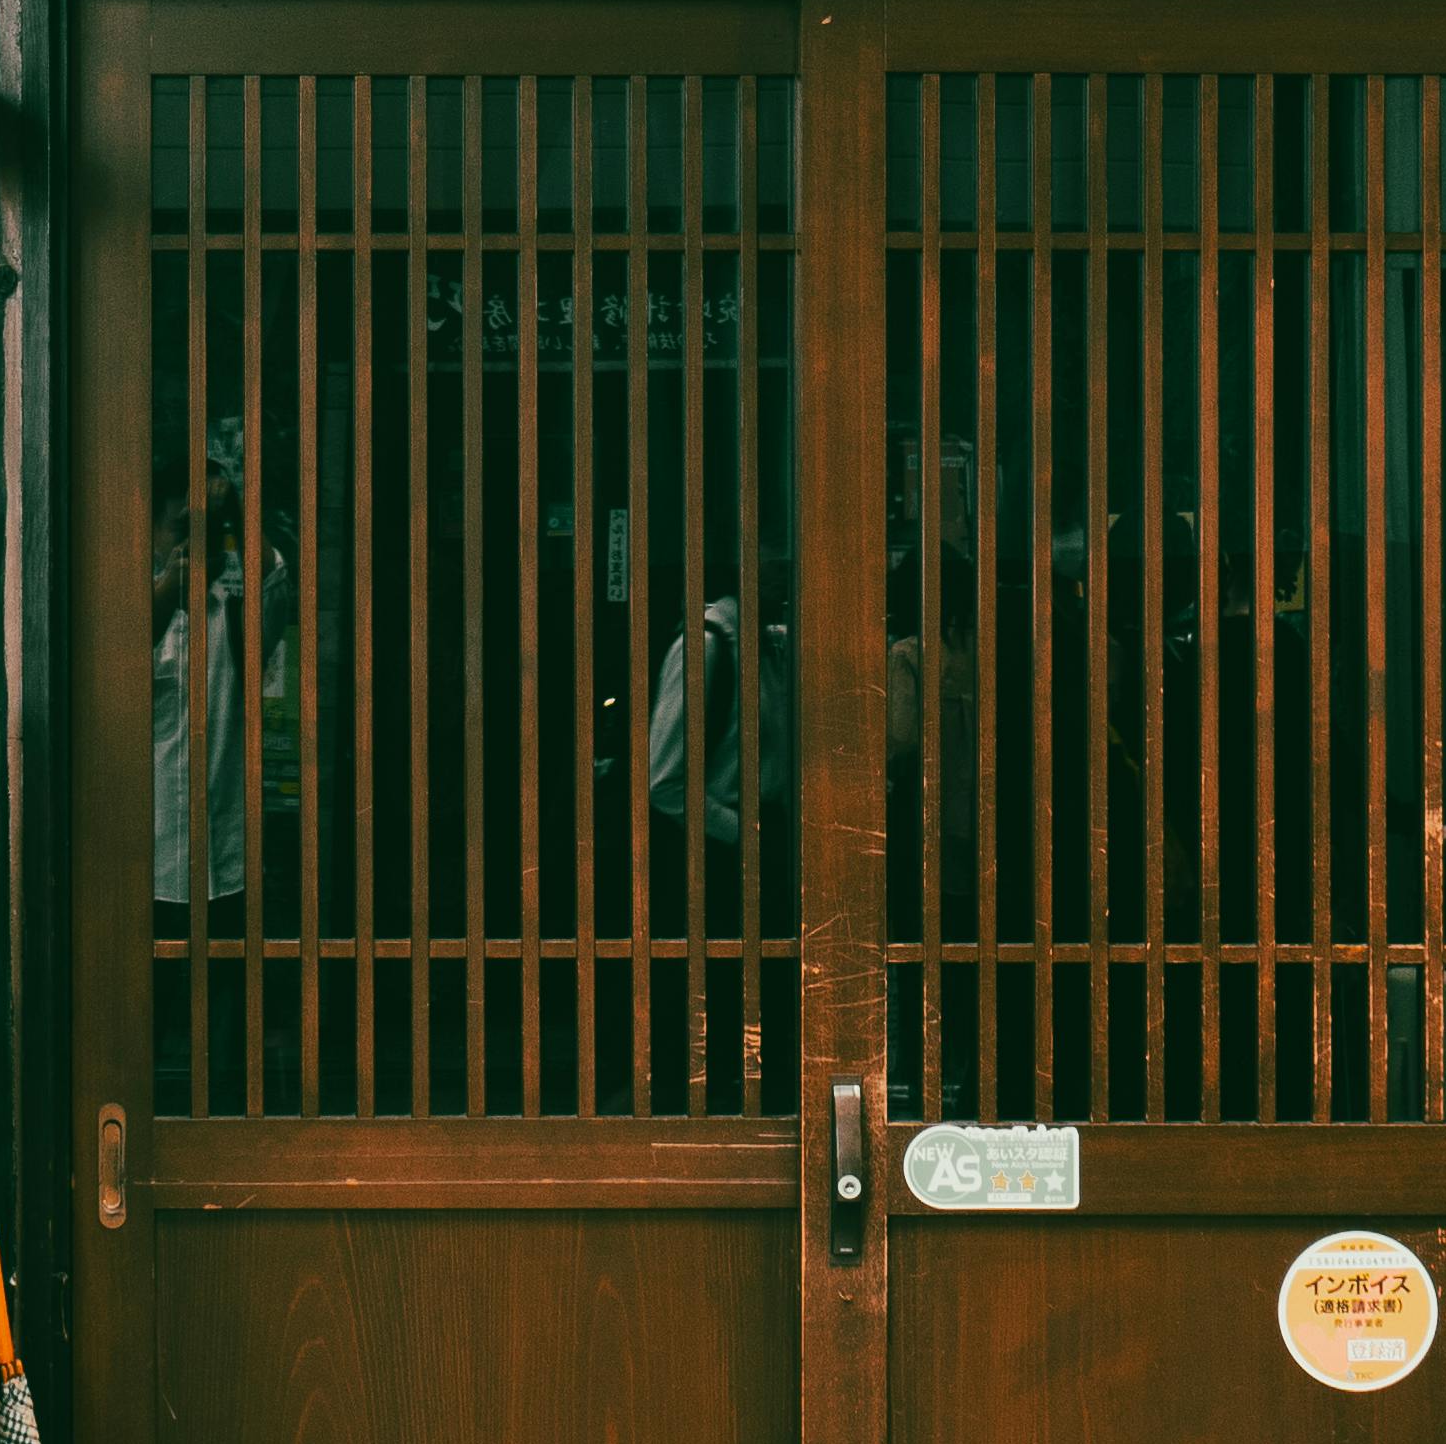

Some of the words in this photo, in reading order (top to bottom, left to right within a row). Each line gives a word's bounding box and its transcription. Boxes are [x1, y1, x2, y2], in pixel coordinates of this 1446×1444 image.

[913, 1143, 955, 1161] NEW
[1305, 1273, 1412, 1295] インボイス
[1314, 1299, 1404, 1315] (適格請求書)
